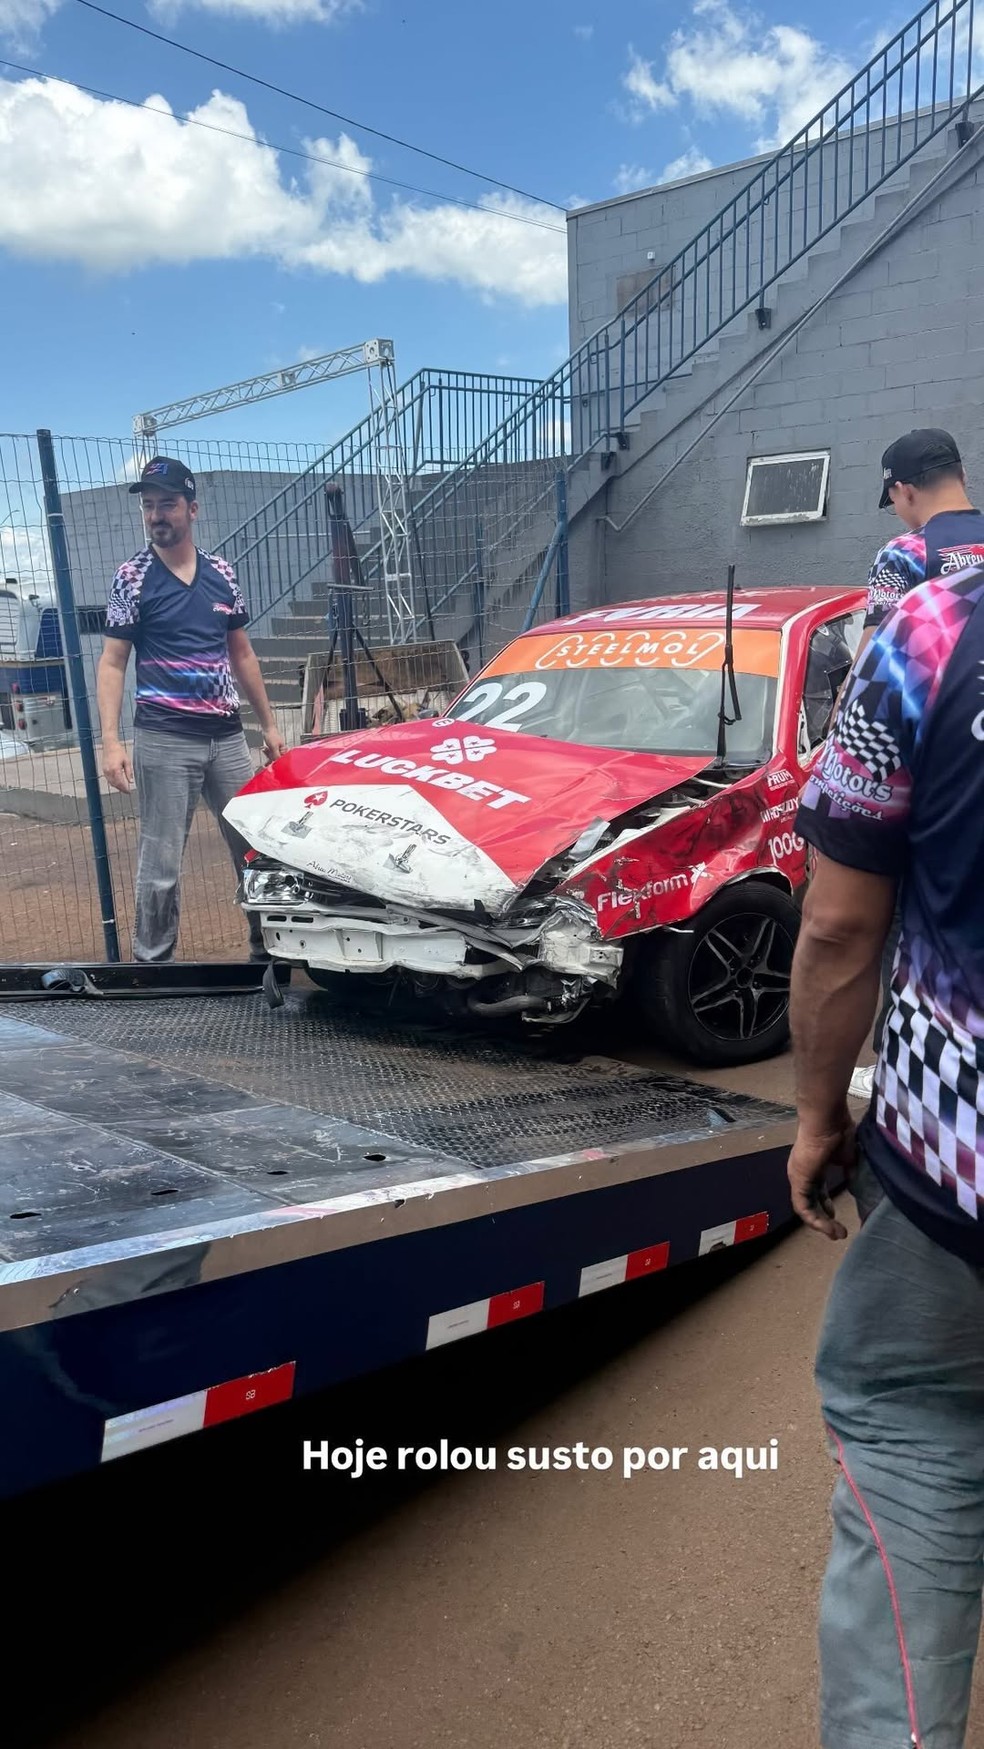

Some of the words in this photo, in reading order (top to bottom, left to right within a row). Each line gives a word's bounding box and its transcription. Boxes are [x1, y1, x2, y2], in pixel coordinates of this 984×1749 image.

[556, 641, 701, 657] STEELMOL
[456, 682, 547, 732] 22
[330, 750, 532, 809] LUCKBET
[818, 741, 893, 802] Motors
[329, 799, 452, 845] POKERSTARS
